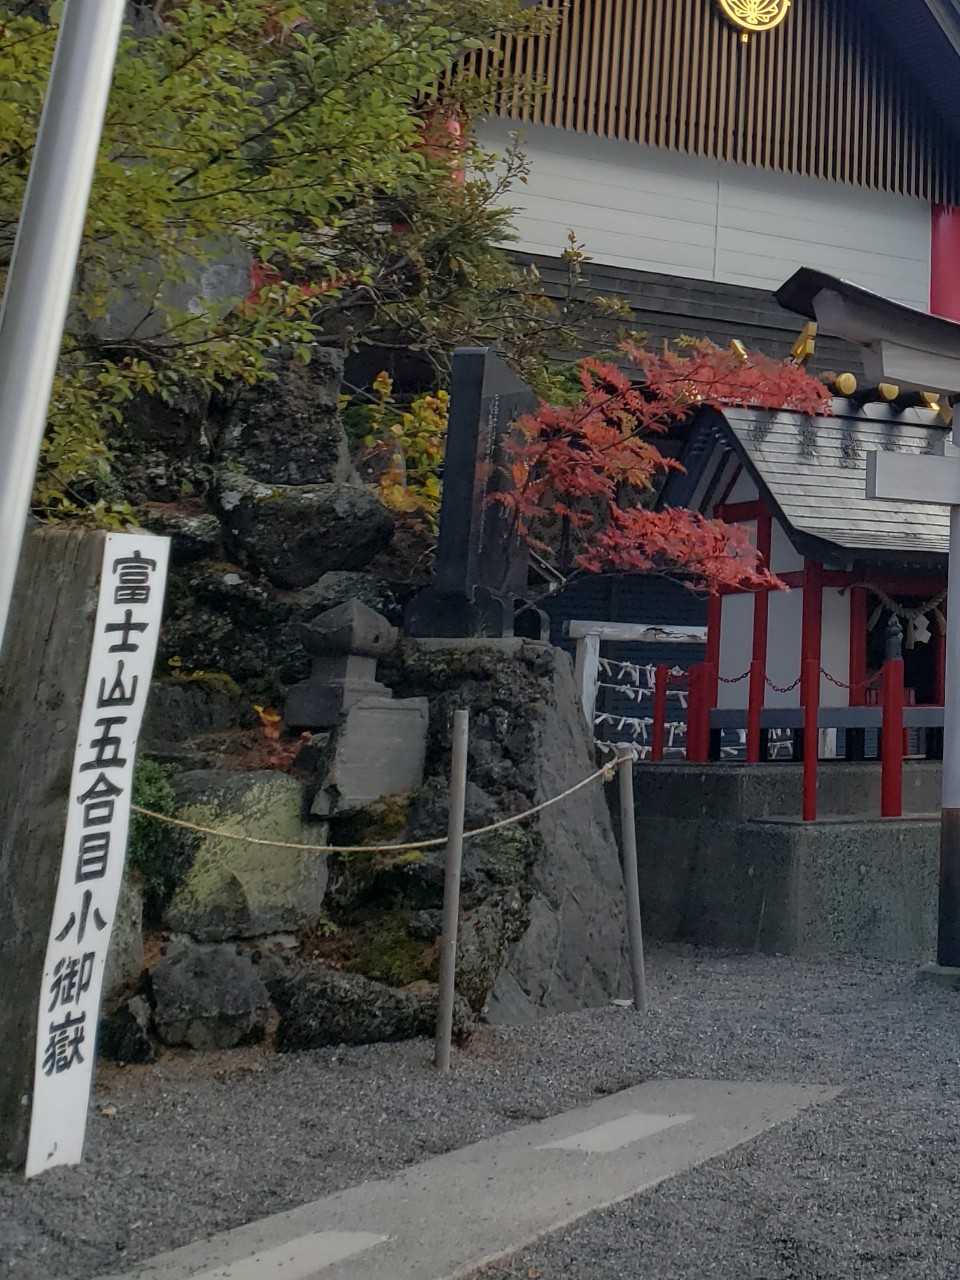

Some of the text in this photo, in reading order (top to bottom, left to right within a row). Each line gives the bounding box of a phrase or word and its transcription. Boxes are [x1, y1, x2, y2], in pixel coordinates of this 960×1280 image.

[42, 549, 157, 1077] 富士山五合目小御嶽
